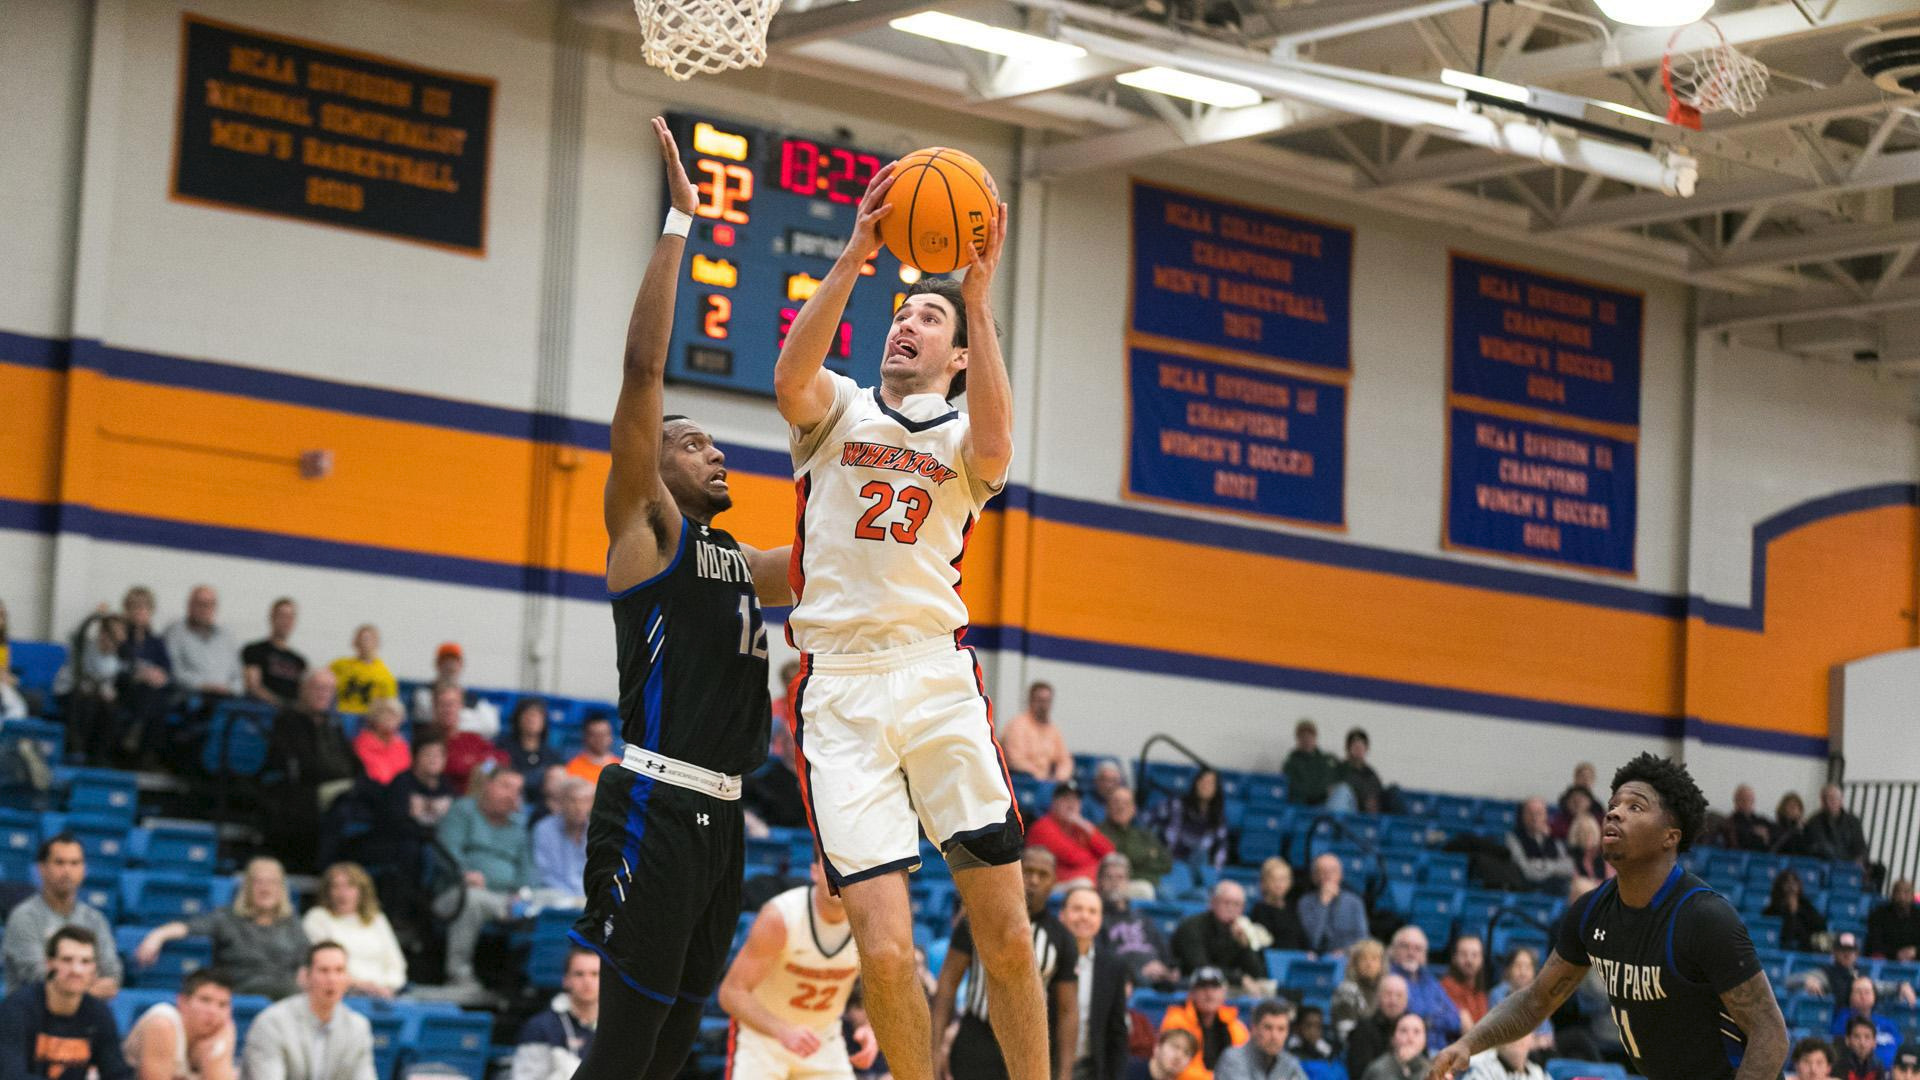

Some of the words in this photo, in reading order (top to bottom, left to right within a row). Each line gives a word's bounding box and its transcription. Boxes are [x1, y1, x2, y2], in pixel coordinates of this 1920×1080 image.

[229, 47, 297, 84] NCAA
[303, 137, 459, 193] BASKETBALL
[696, 159, 753, 225] 32
[704, 293, 732, 339] 2
[841, 442, 957, 485] WHEATON
[855, 480, 933, 544] 23
[1623, 963, 1667, 1000] PARK
